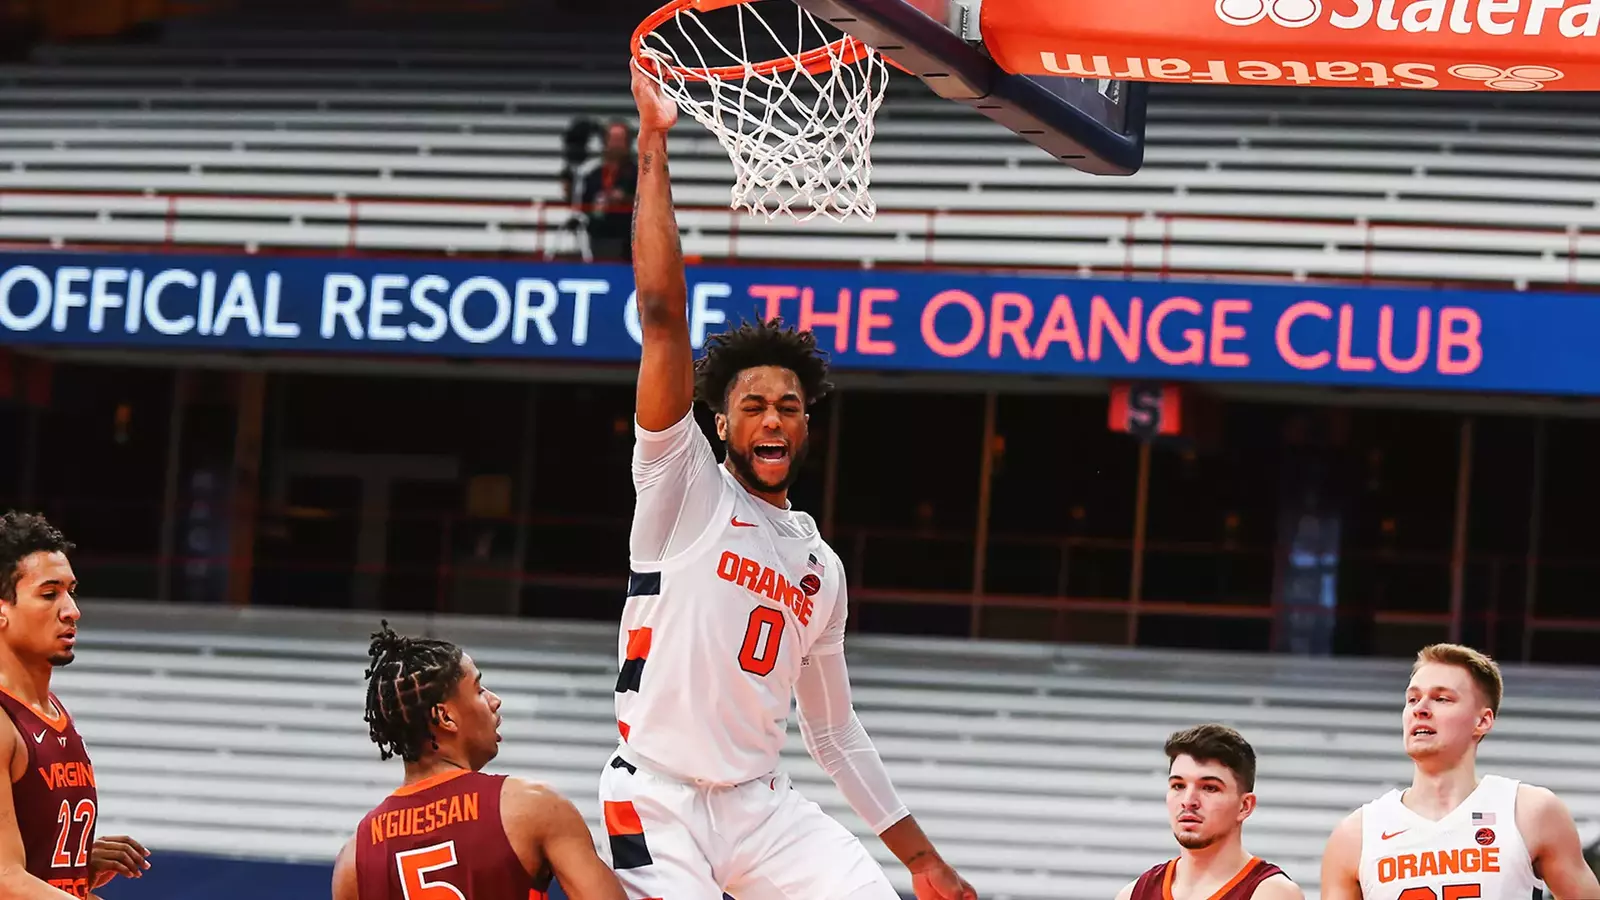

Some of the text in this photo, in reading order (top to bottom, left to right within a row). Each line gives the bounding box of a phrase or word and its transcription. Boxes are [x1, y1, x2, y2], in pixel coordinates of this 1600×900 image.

[0, 266, 300, 339] OFFICIAL
[320, 273, 609, 346] RESORT
[747, 284, 898, 356] THE
[920, 288, 1250, 366] ORANGE
[1275, 301, 1483, 375] CLUB
[717, 550, 814, 627] ORANGE
[738, 605, 785, 677] 0
[51, 799, 96, 868] 22
[371, 792, 478, 845] N'GUESSAN
[396, 840, 468, 900] 5
[1378, 847, 1500, 884] ORANGE
